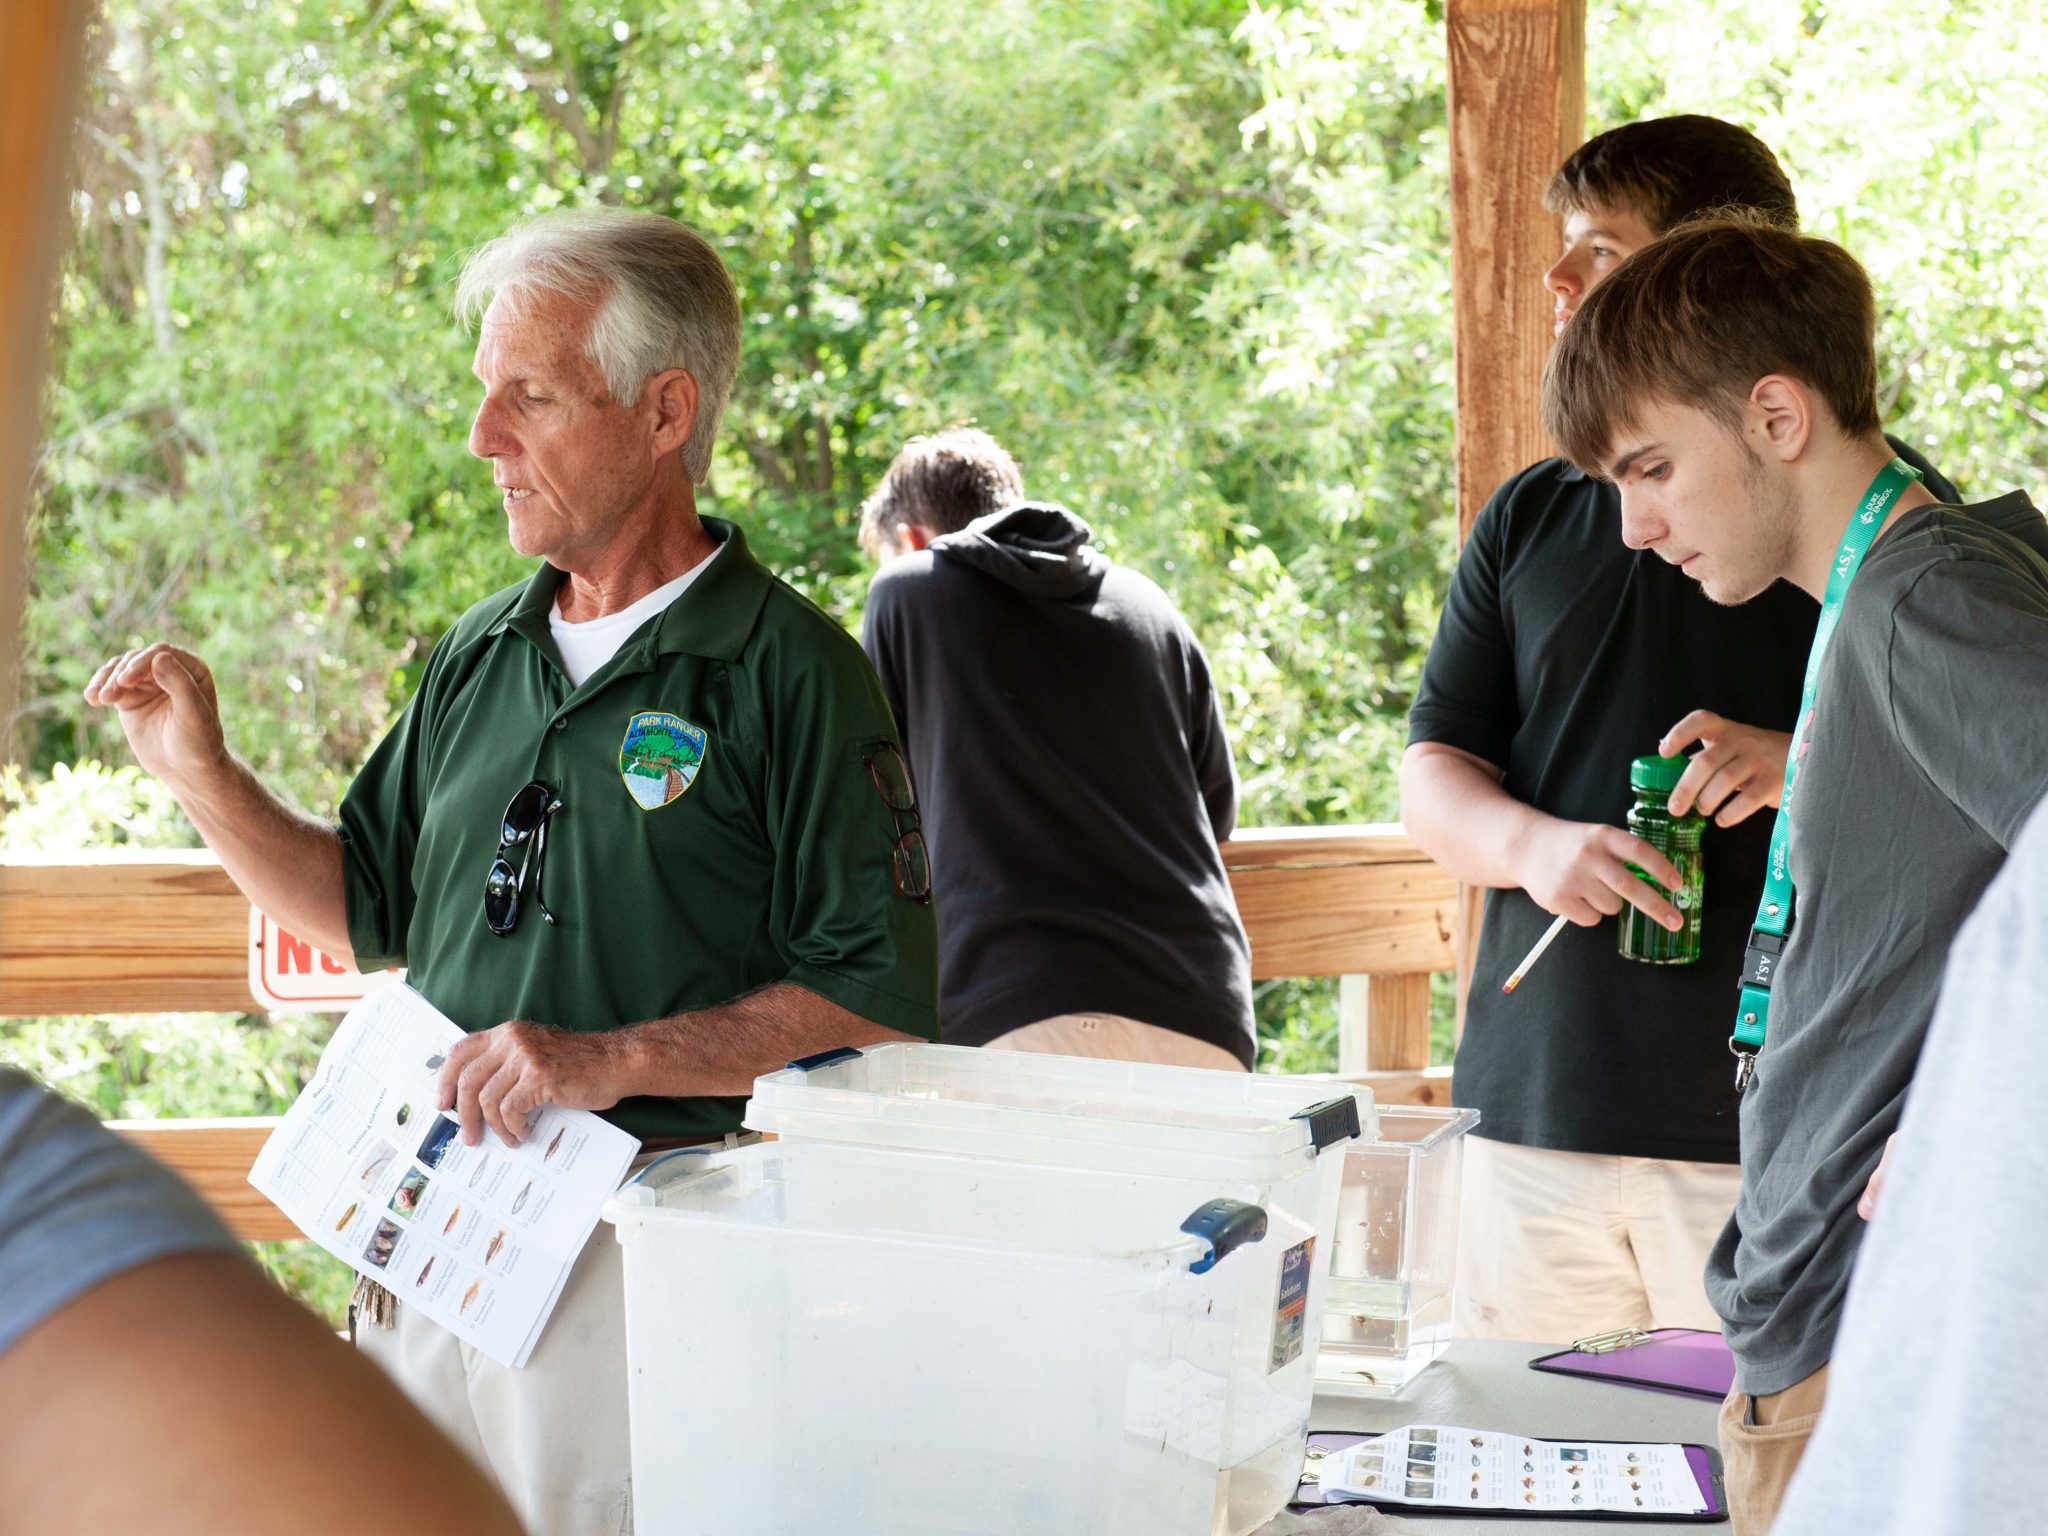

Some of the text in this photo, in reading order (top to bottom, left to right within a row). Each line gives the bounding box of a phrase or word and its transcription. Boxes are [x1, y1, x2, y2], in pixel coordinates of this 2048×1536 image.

[1866, 493, 1880, 510] DUKE
[1873, 489, 1891, 514] ENERGY
[630, 727, 672, 738] ALTAMONTE
[638, 717, 700, 740] PARK RANGER
